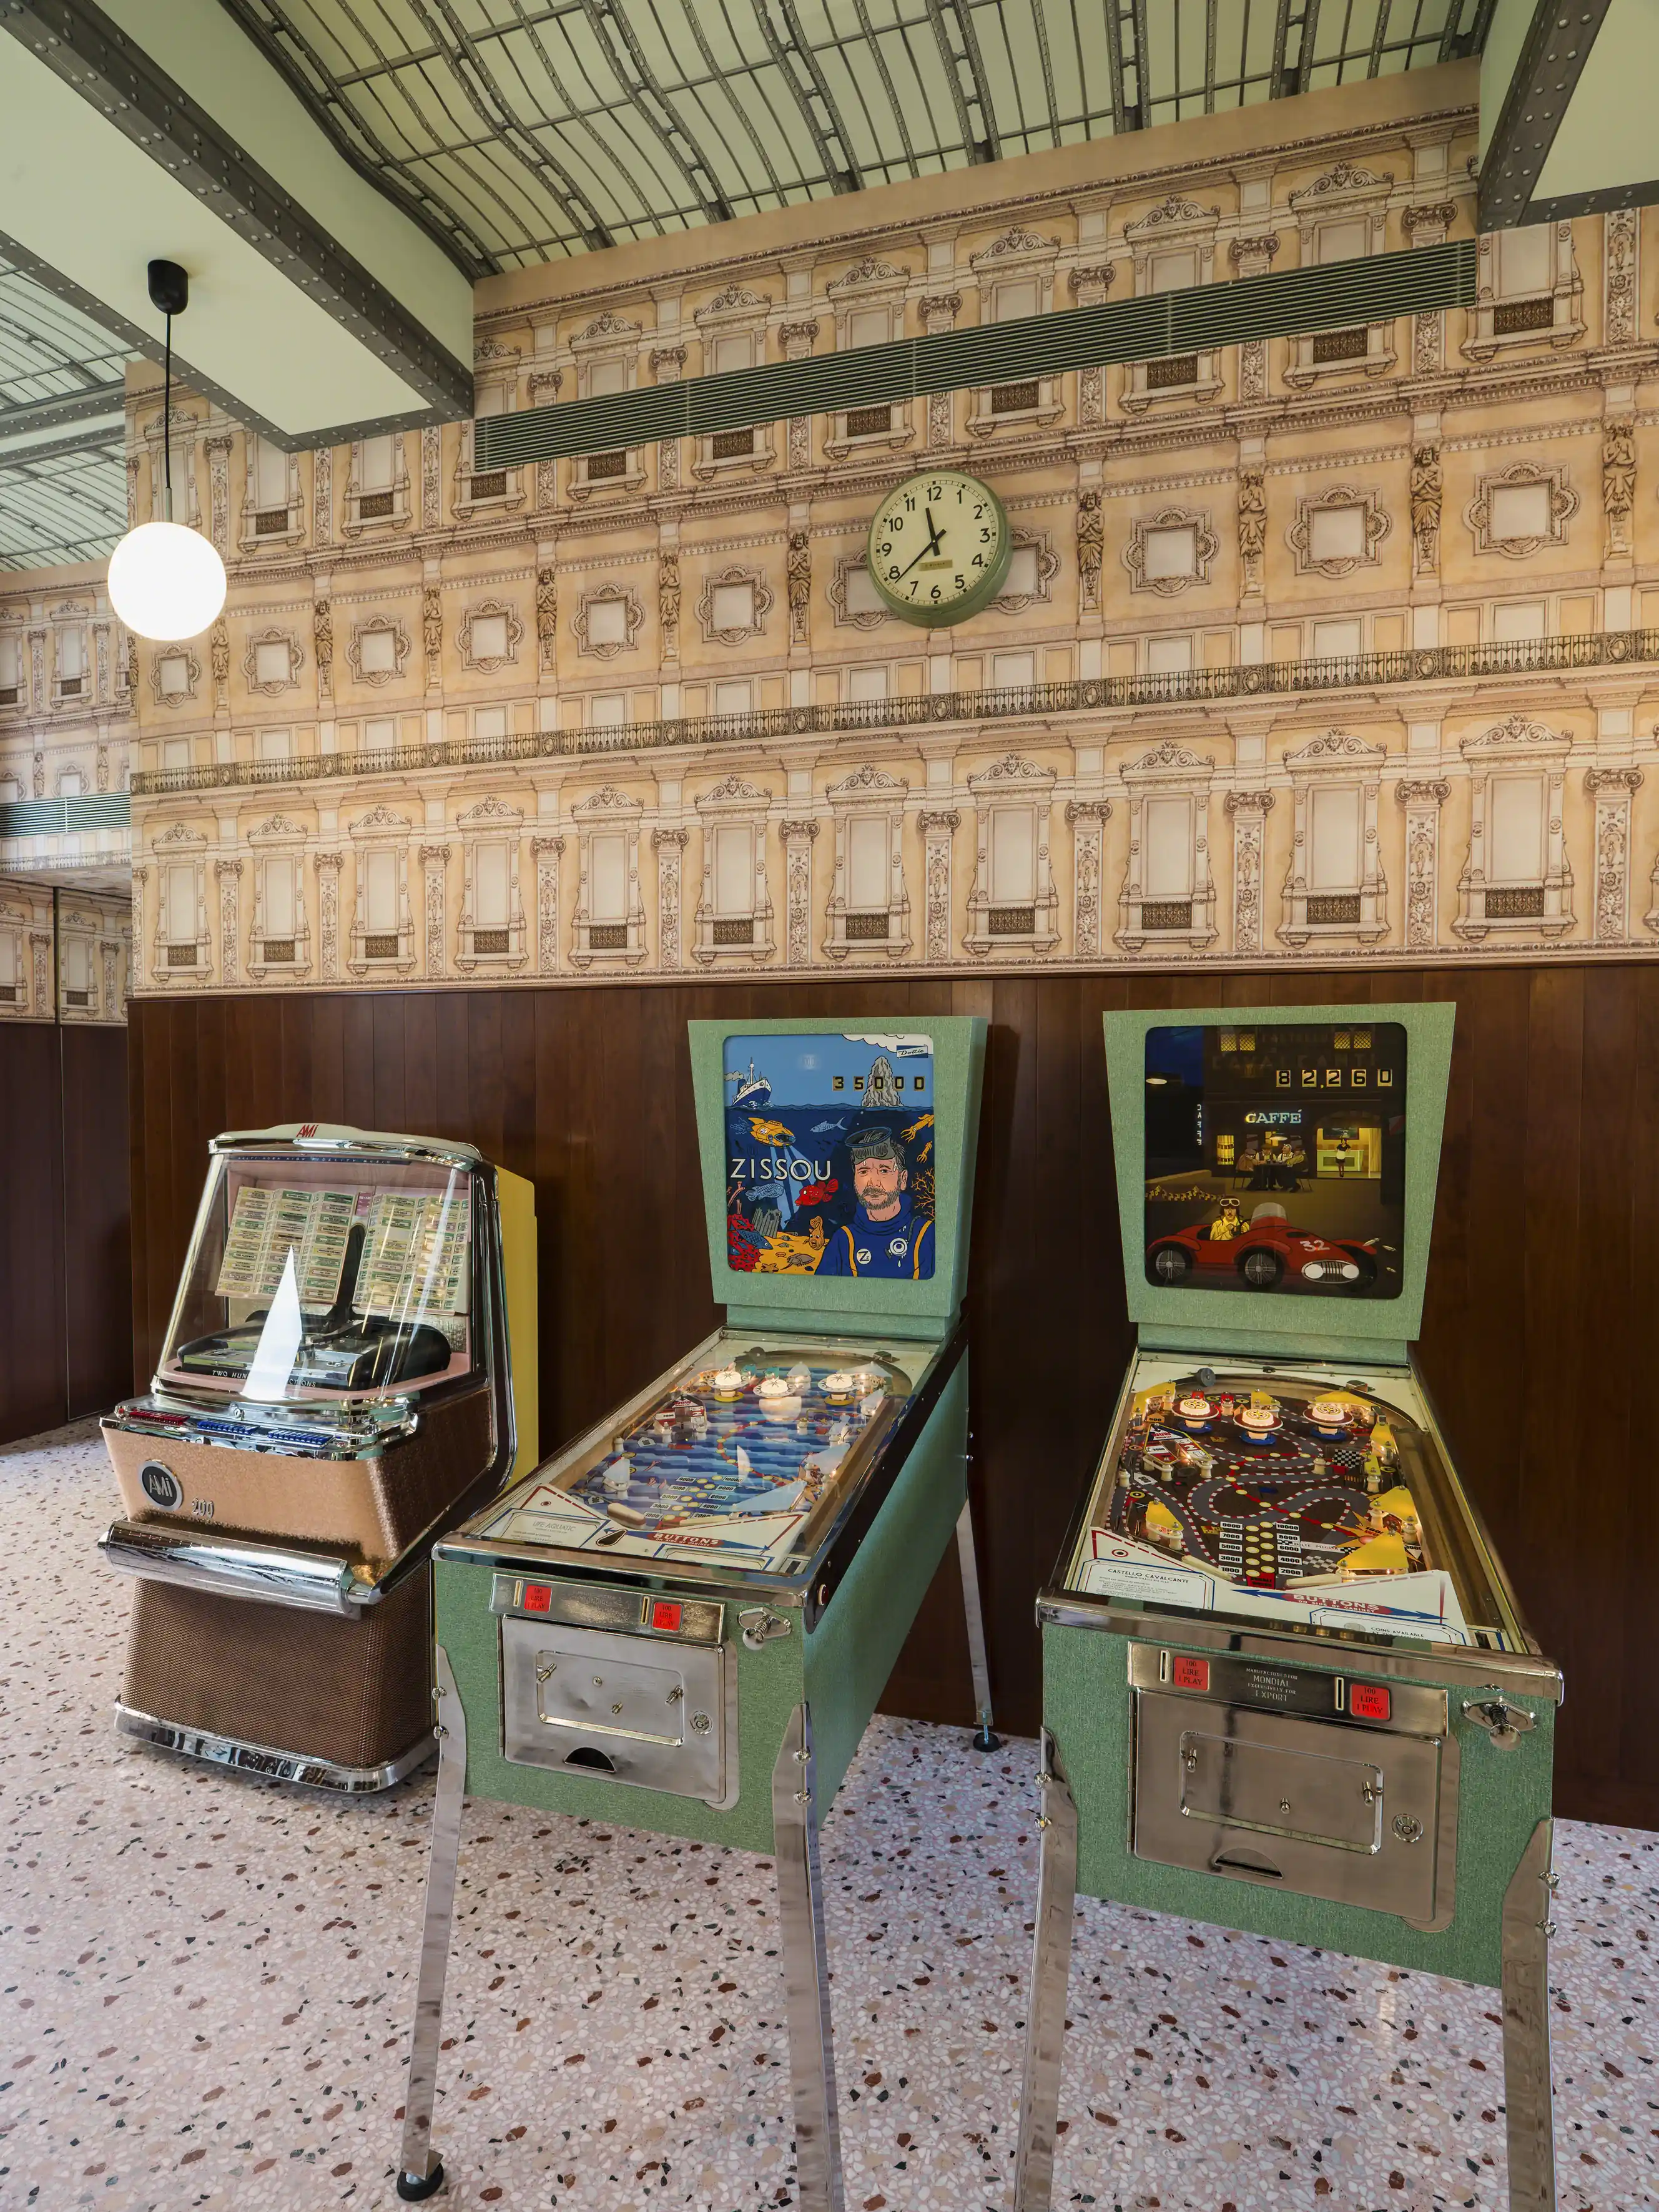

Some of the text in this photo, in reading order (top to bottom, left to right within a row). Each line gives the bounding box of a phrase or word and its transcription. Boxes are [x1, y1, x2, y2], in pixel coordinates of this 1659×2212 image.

[927, 486, 942, 501] 12
[957, 489, 962, 504] 1
[905, 497, 915, 511] 11
[973, 504, 983, 519] 2
[889, 517, 903, 532] 10
[980, 528, 990, 543] 3
[881, 543, 892, 557] 9
[972, 553, 984, 568] 4
[889, 566, 900, 579] 8
[910, 581, 919, 596] 7
[955, 574, 965, 589] 5
[930, 585, 941, 599] 6
[731, 1158, 830, 1181] ZISSOU
[1299, 1240, 1330, 1252] 32
[192, 1497, 214, 1518] 200
[545, 1523, 576, 1531] AQUATIC
[653, 1533, 719, 1545] BUTTONS
[1108, 1568, 1143, 1577] CASTELLO
[1145, 1574, 1188, 1583] CAVALCANTI
[1293, 1594, 1379, 1610] BUTTONS
[1182, 1668, 1199, 1676] LIRE
[1183, 1676, 1203, 1685] PLAY
[1253, 1674, 1289, 1687] MONDIAL
[1256, 1689, 1287, 1702] EXPORT
[1361, 1695, 1379, 1704] LIRE
[1362, 1704, 1382, 1713] PLAY
